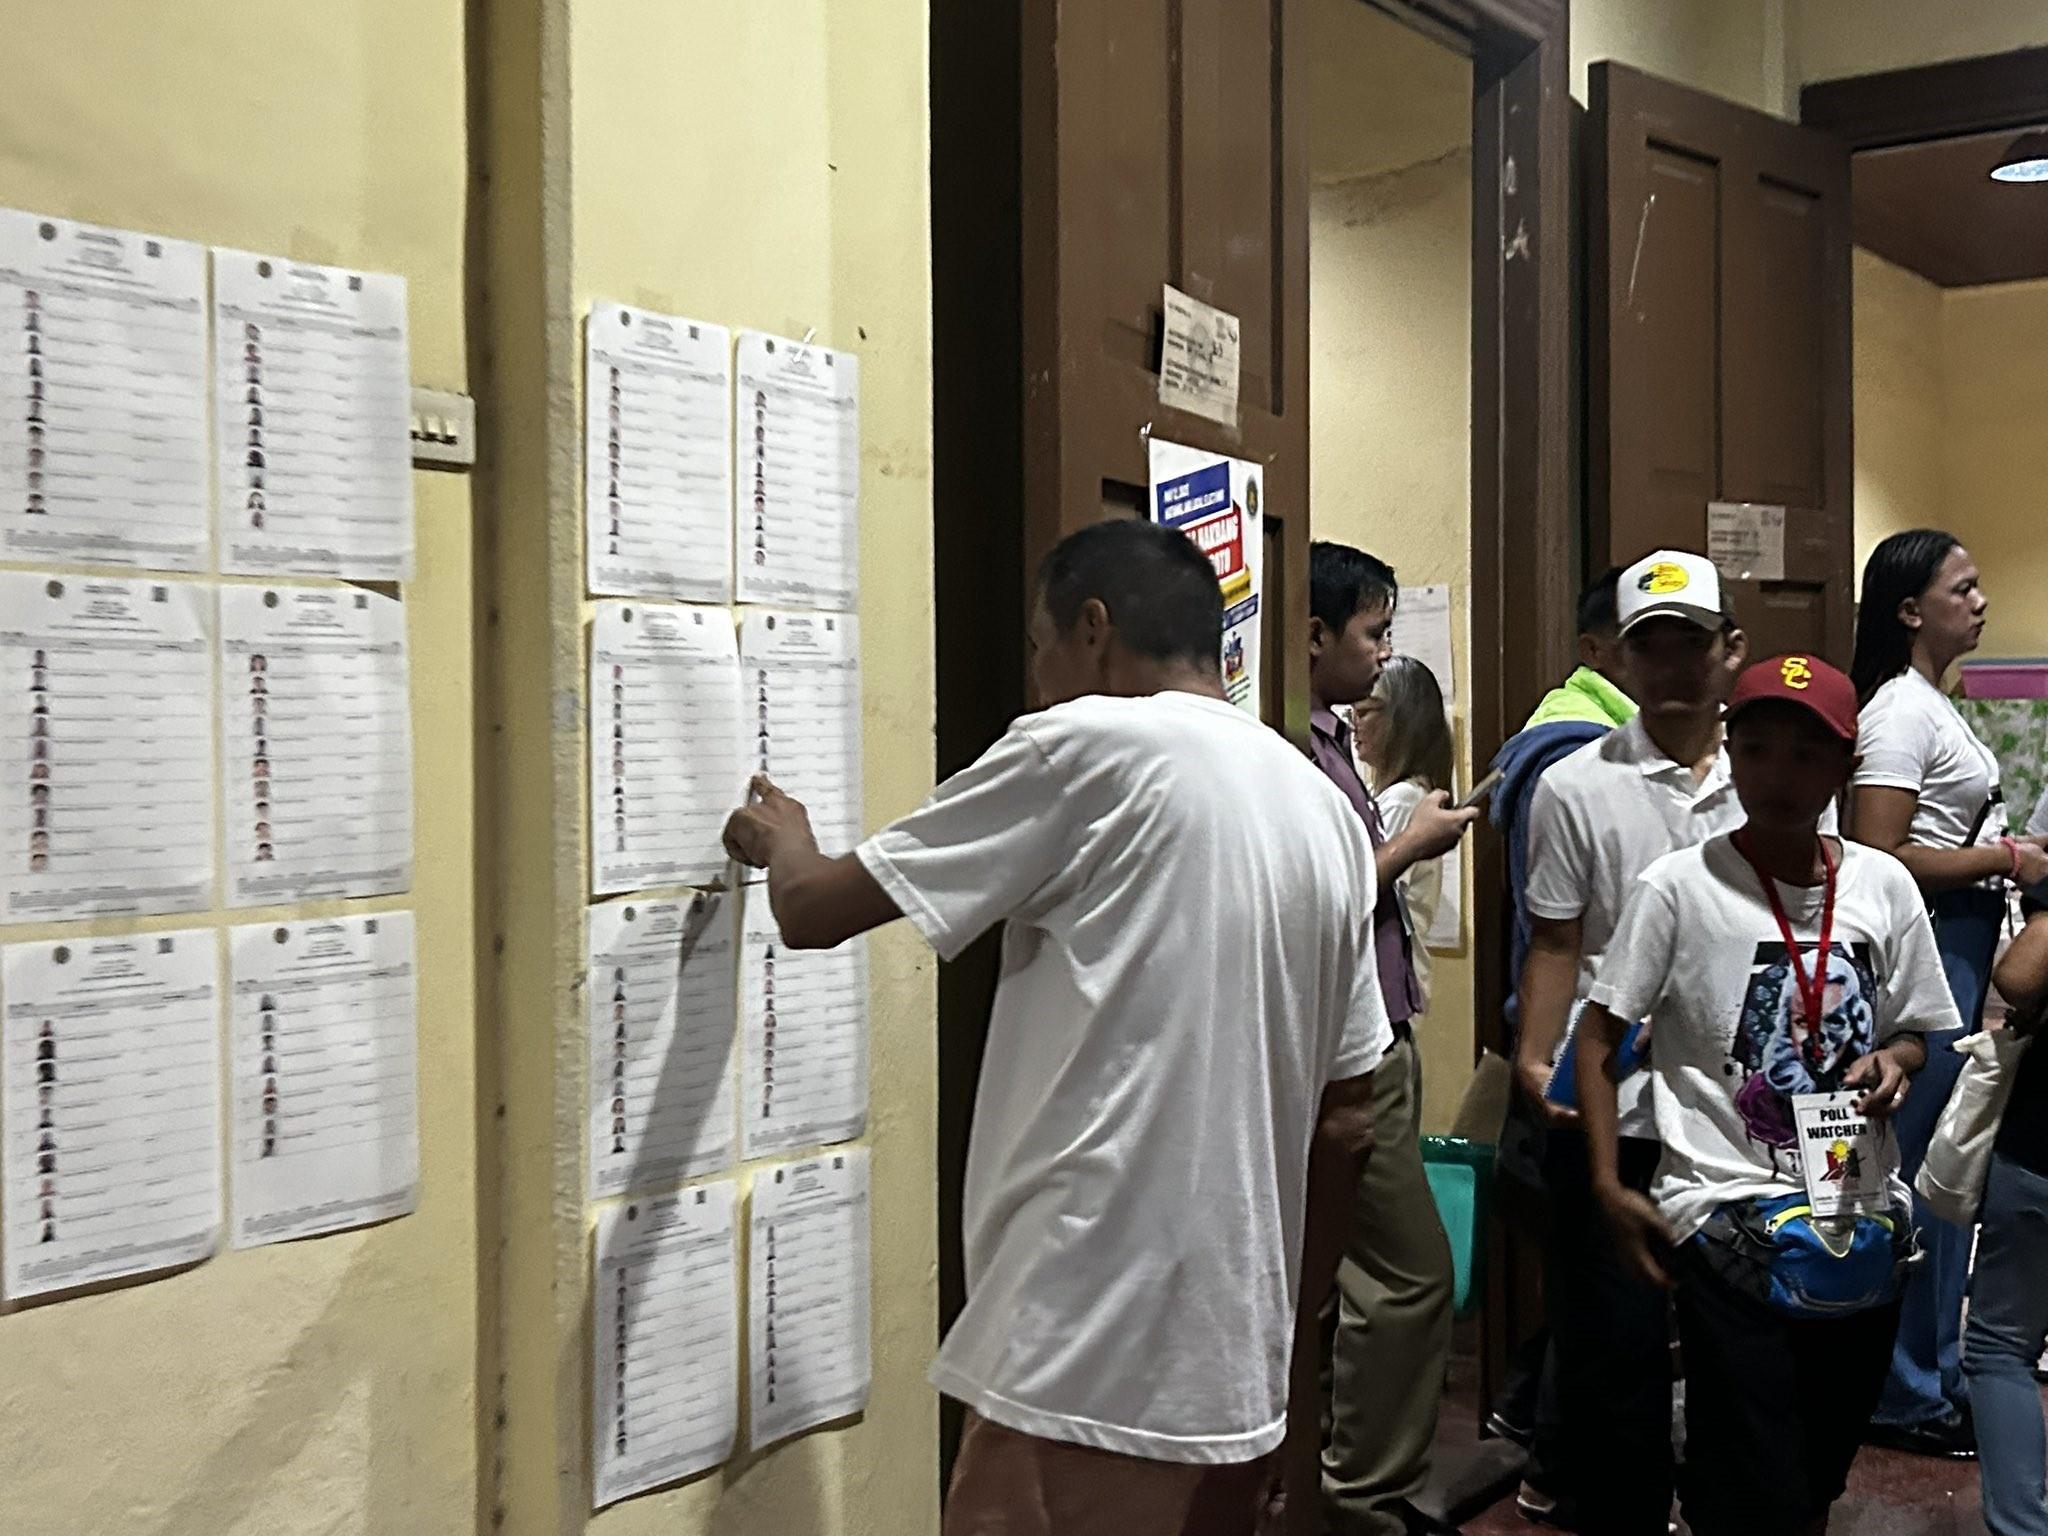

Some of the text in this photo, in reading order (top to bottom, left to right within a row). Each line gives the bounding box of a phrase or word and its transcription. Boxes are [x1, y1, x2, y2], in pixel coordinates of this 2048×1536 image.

[1781, 656, 1812, 689] SC
[1820, 1108, 1850, 1122] POLL
[1807, 1123, 1868, 1139] WATCHER
